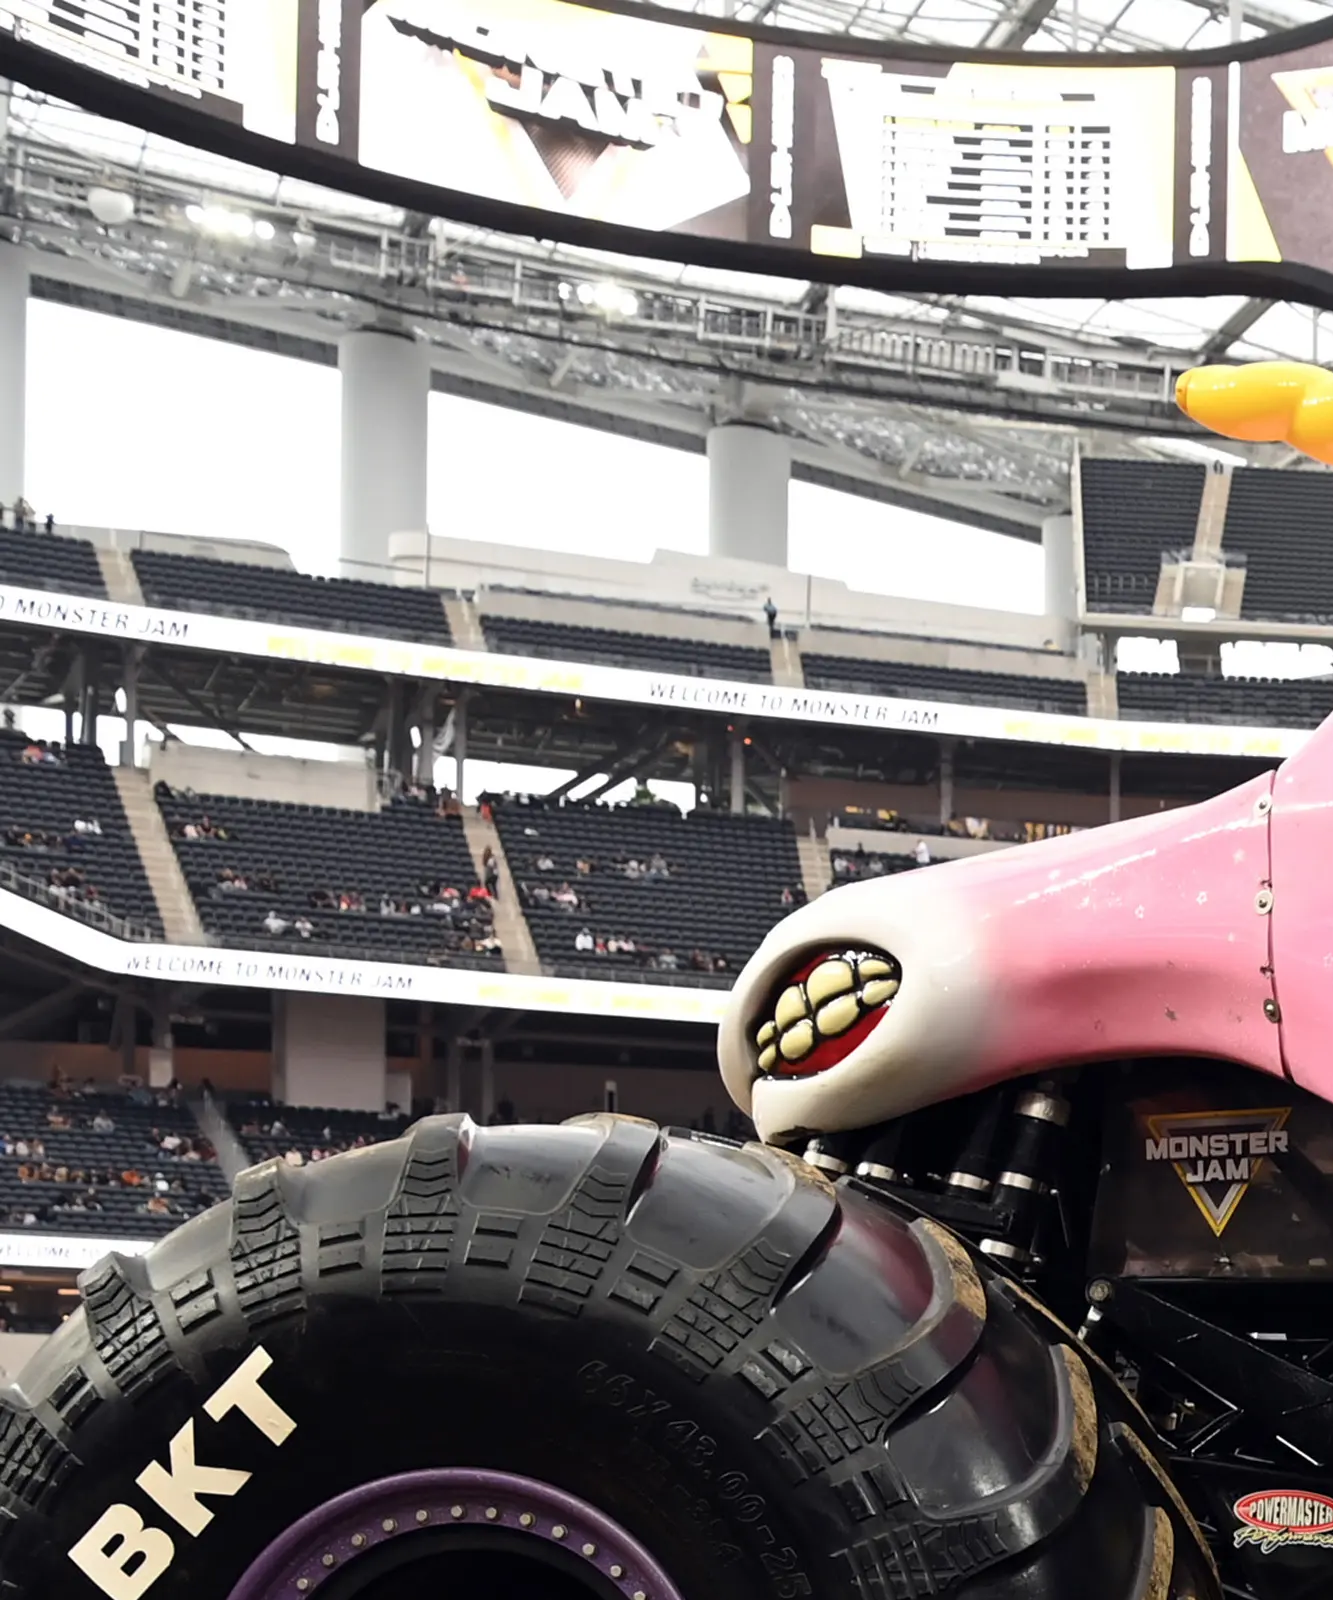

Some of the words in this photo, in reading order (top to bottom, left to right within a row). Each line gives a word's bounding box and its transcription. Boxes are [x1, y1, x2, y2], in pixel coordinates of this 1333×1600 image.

[15, 596, 129, 631] MONSTER
[138, 616, 191, 639] JAM
[649, 680, 748, 708] WELCOME
[758, 694, 783, 711] TO
[790, 697, 888, 722] MONSTER
[897, 708, 940, 726] JAM
[126, 955, 225, 977] WELCOME
[234, 961, 259, 978] TO
[265, 964, 364, 987] MONSTER
[370, 973, 414, 991] JAM
[1145, 1130, 1289, 1161] MONSTER
[1185, 1157, 1250, 1184] JAM
